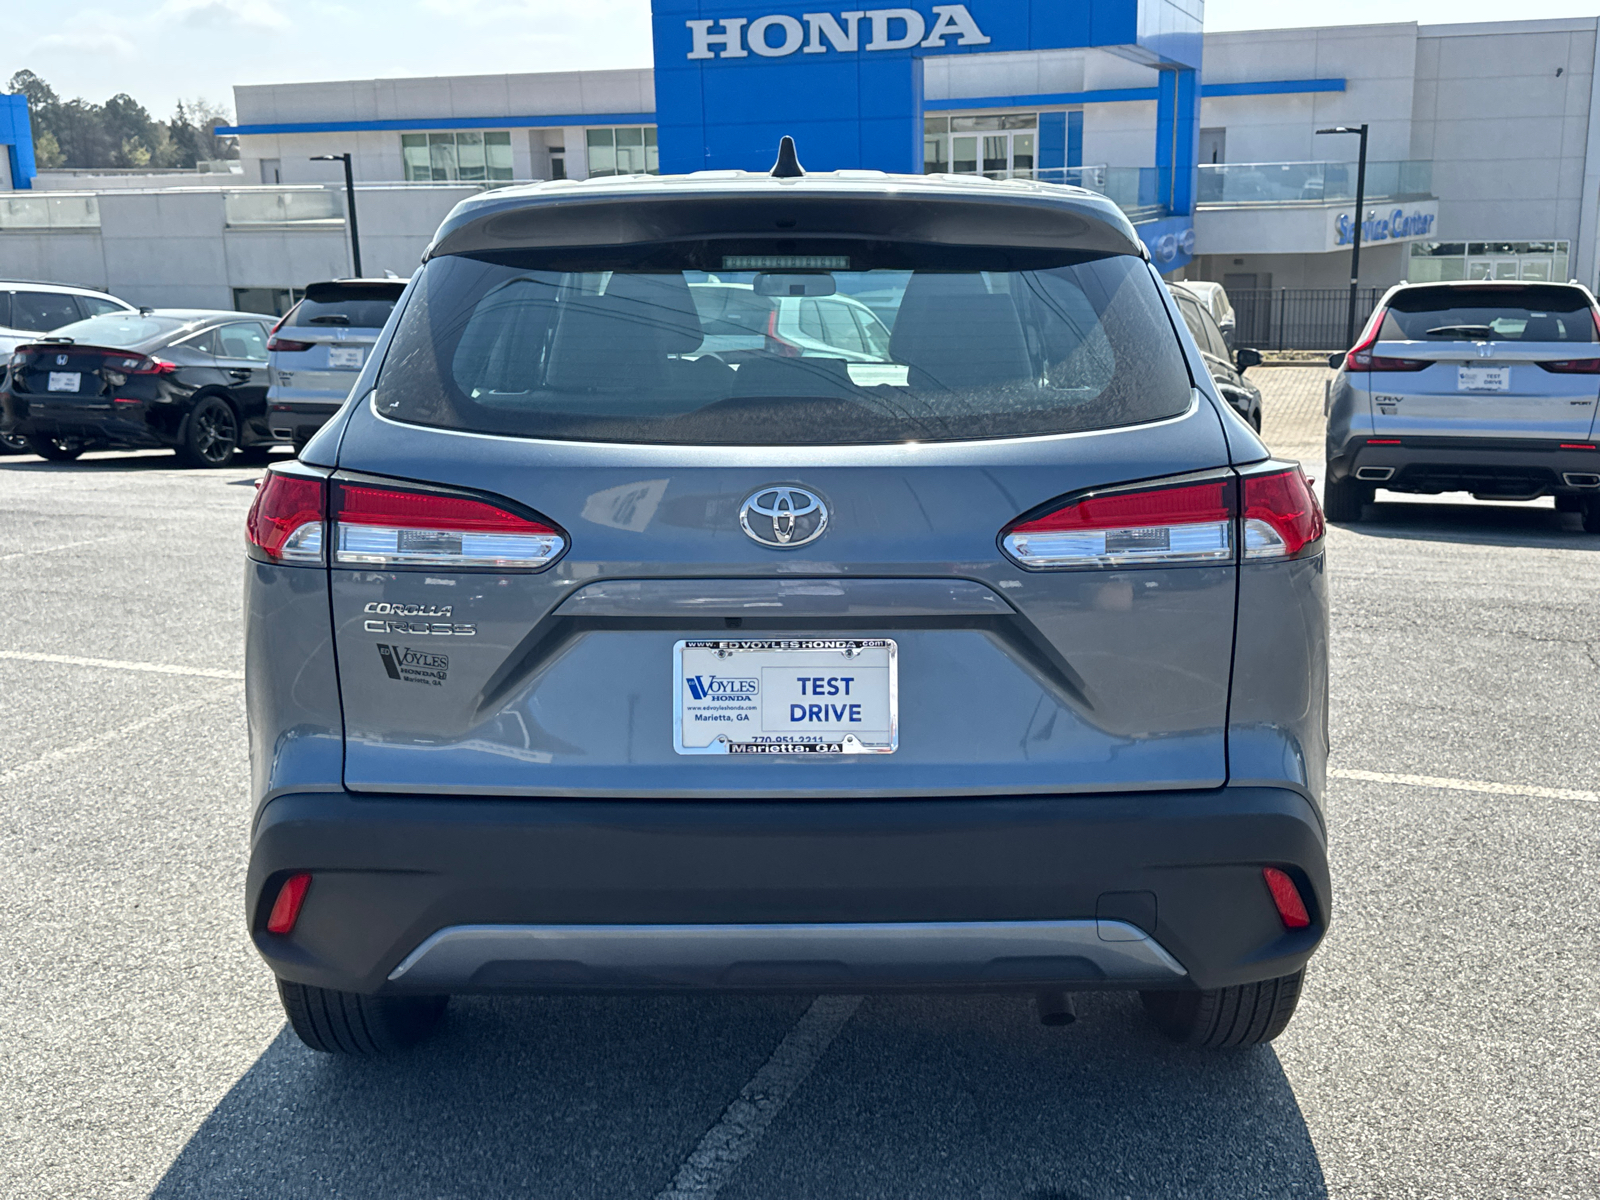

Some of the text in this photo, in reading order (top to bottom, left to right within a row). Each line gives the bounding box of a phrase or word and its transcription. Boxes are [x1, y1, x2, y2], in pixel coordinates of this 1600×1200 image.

[686, 4, 991, 59] HONDA
[1388, 209, 1435, 239] Center
[364, 602, 453, 617] COROLLA
[364, 620, 477, 635] CROSS
[392, 645, 447, 668] VOYLES
[401, 667, 436, 678] HONDA
[403, 675, 431, 686] Marietta,
[695, 675, 756, 698] VOYLES
[797, 677, 854, 696] TEST
[694, 713, 750, 722] Marietta, GA
[790, 704, 862, 722] DRIVE
[732, 743, 840, 752] Marietta, GA
